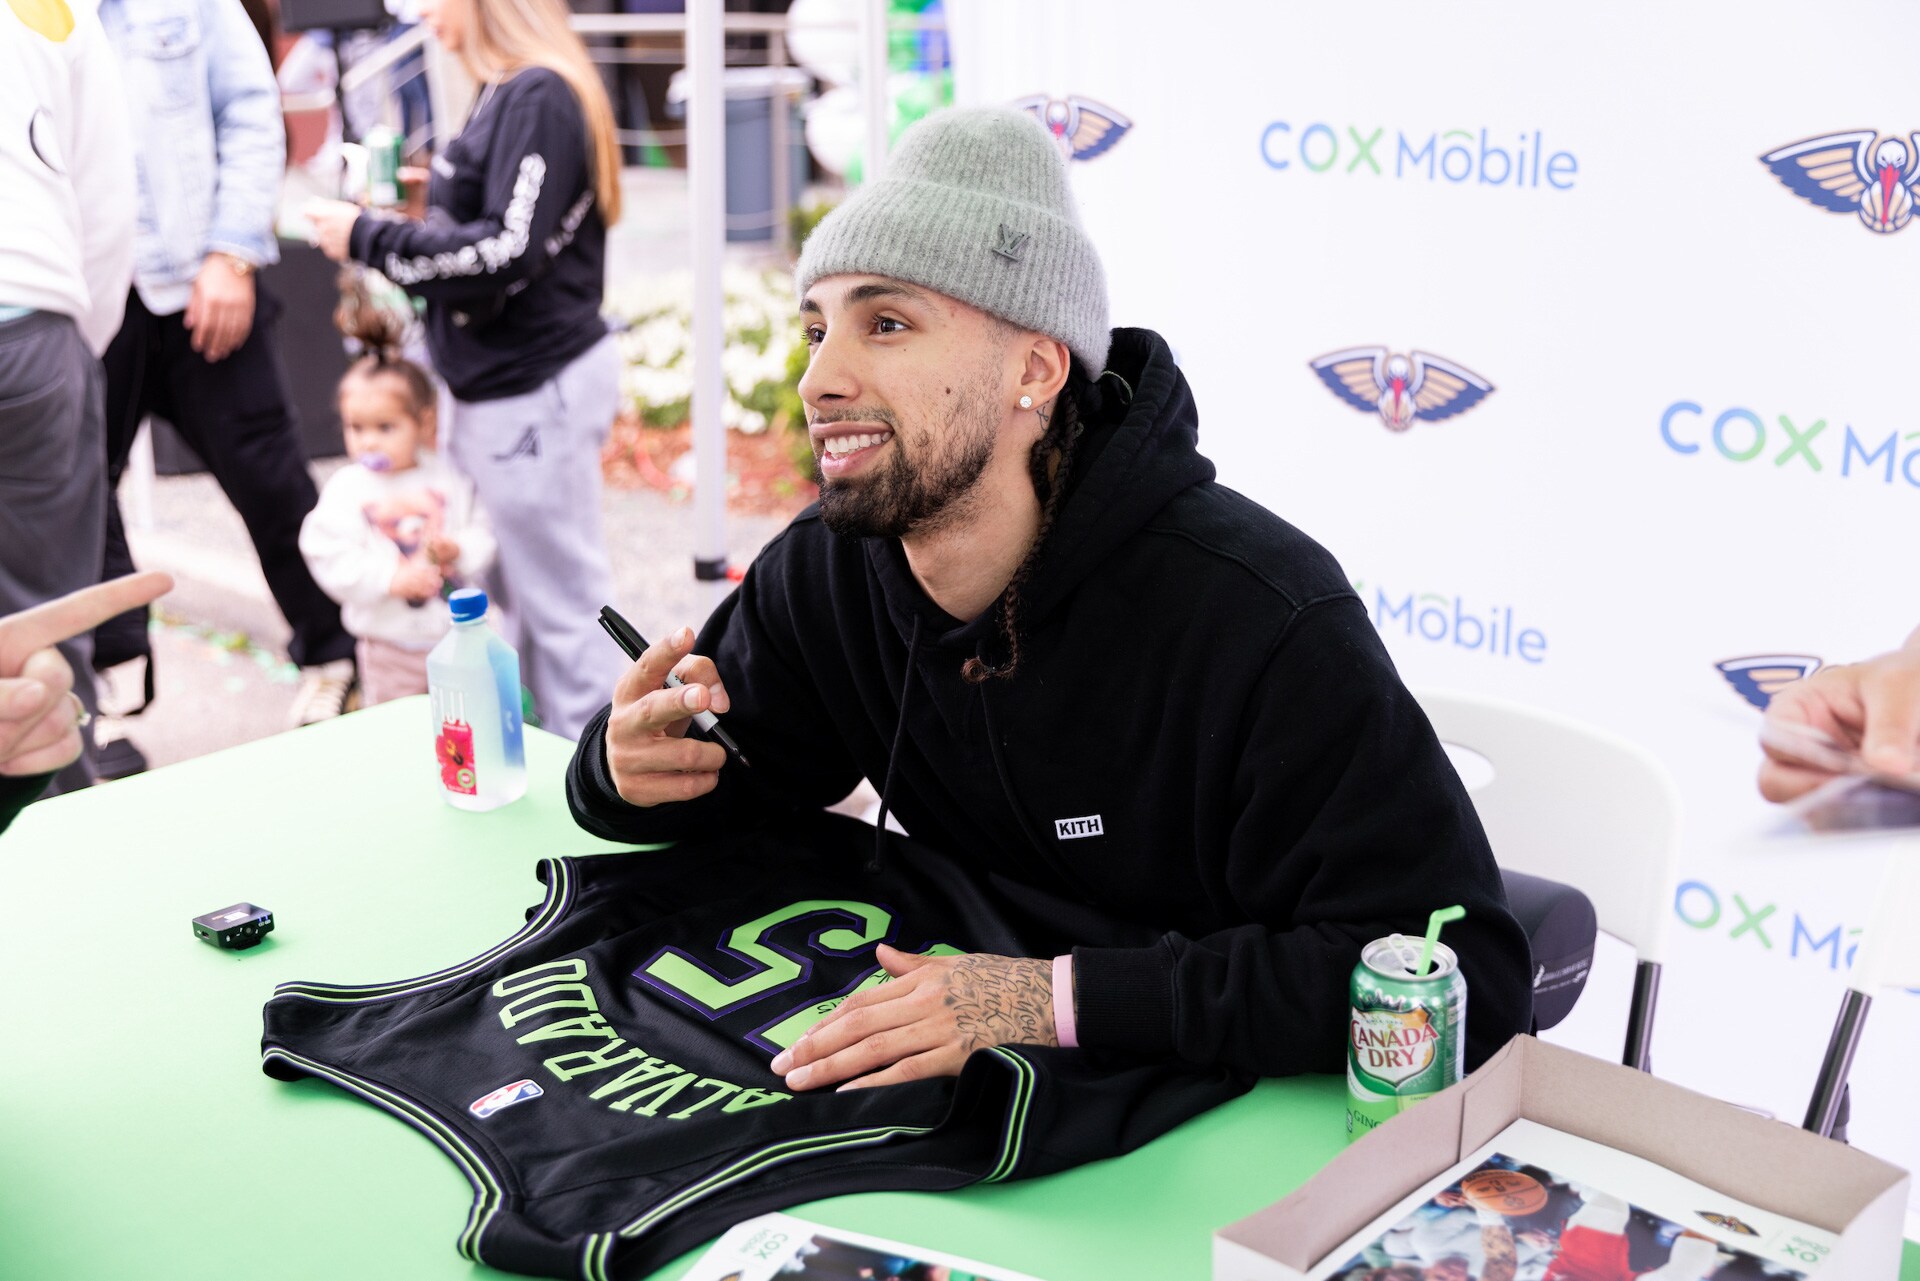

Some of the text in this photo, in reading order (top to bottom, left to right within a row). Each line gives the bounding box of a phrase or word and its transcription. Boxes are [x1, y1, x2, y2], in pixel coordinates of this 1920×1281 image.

[1261, 121, 1384, 175] COX
[1660, 400, 1827, 472] COX
[1059, 819, 1100, 836] KITH
[1674, 880, 1776, 949] OX
[492, 958, 794, 1120] ALVARADO
[1351, 1020, 1439, 1050] CANADA
[1368, 1047, 1416, 1069] DRY
[1780, 1243, 1818, 1264] OX
